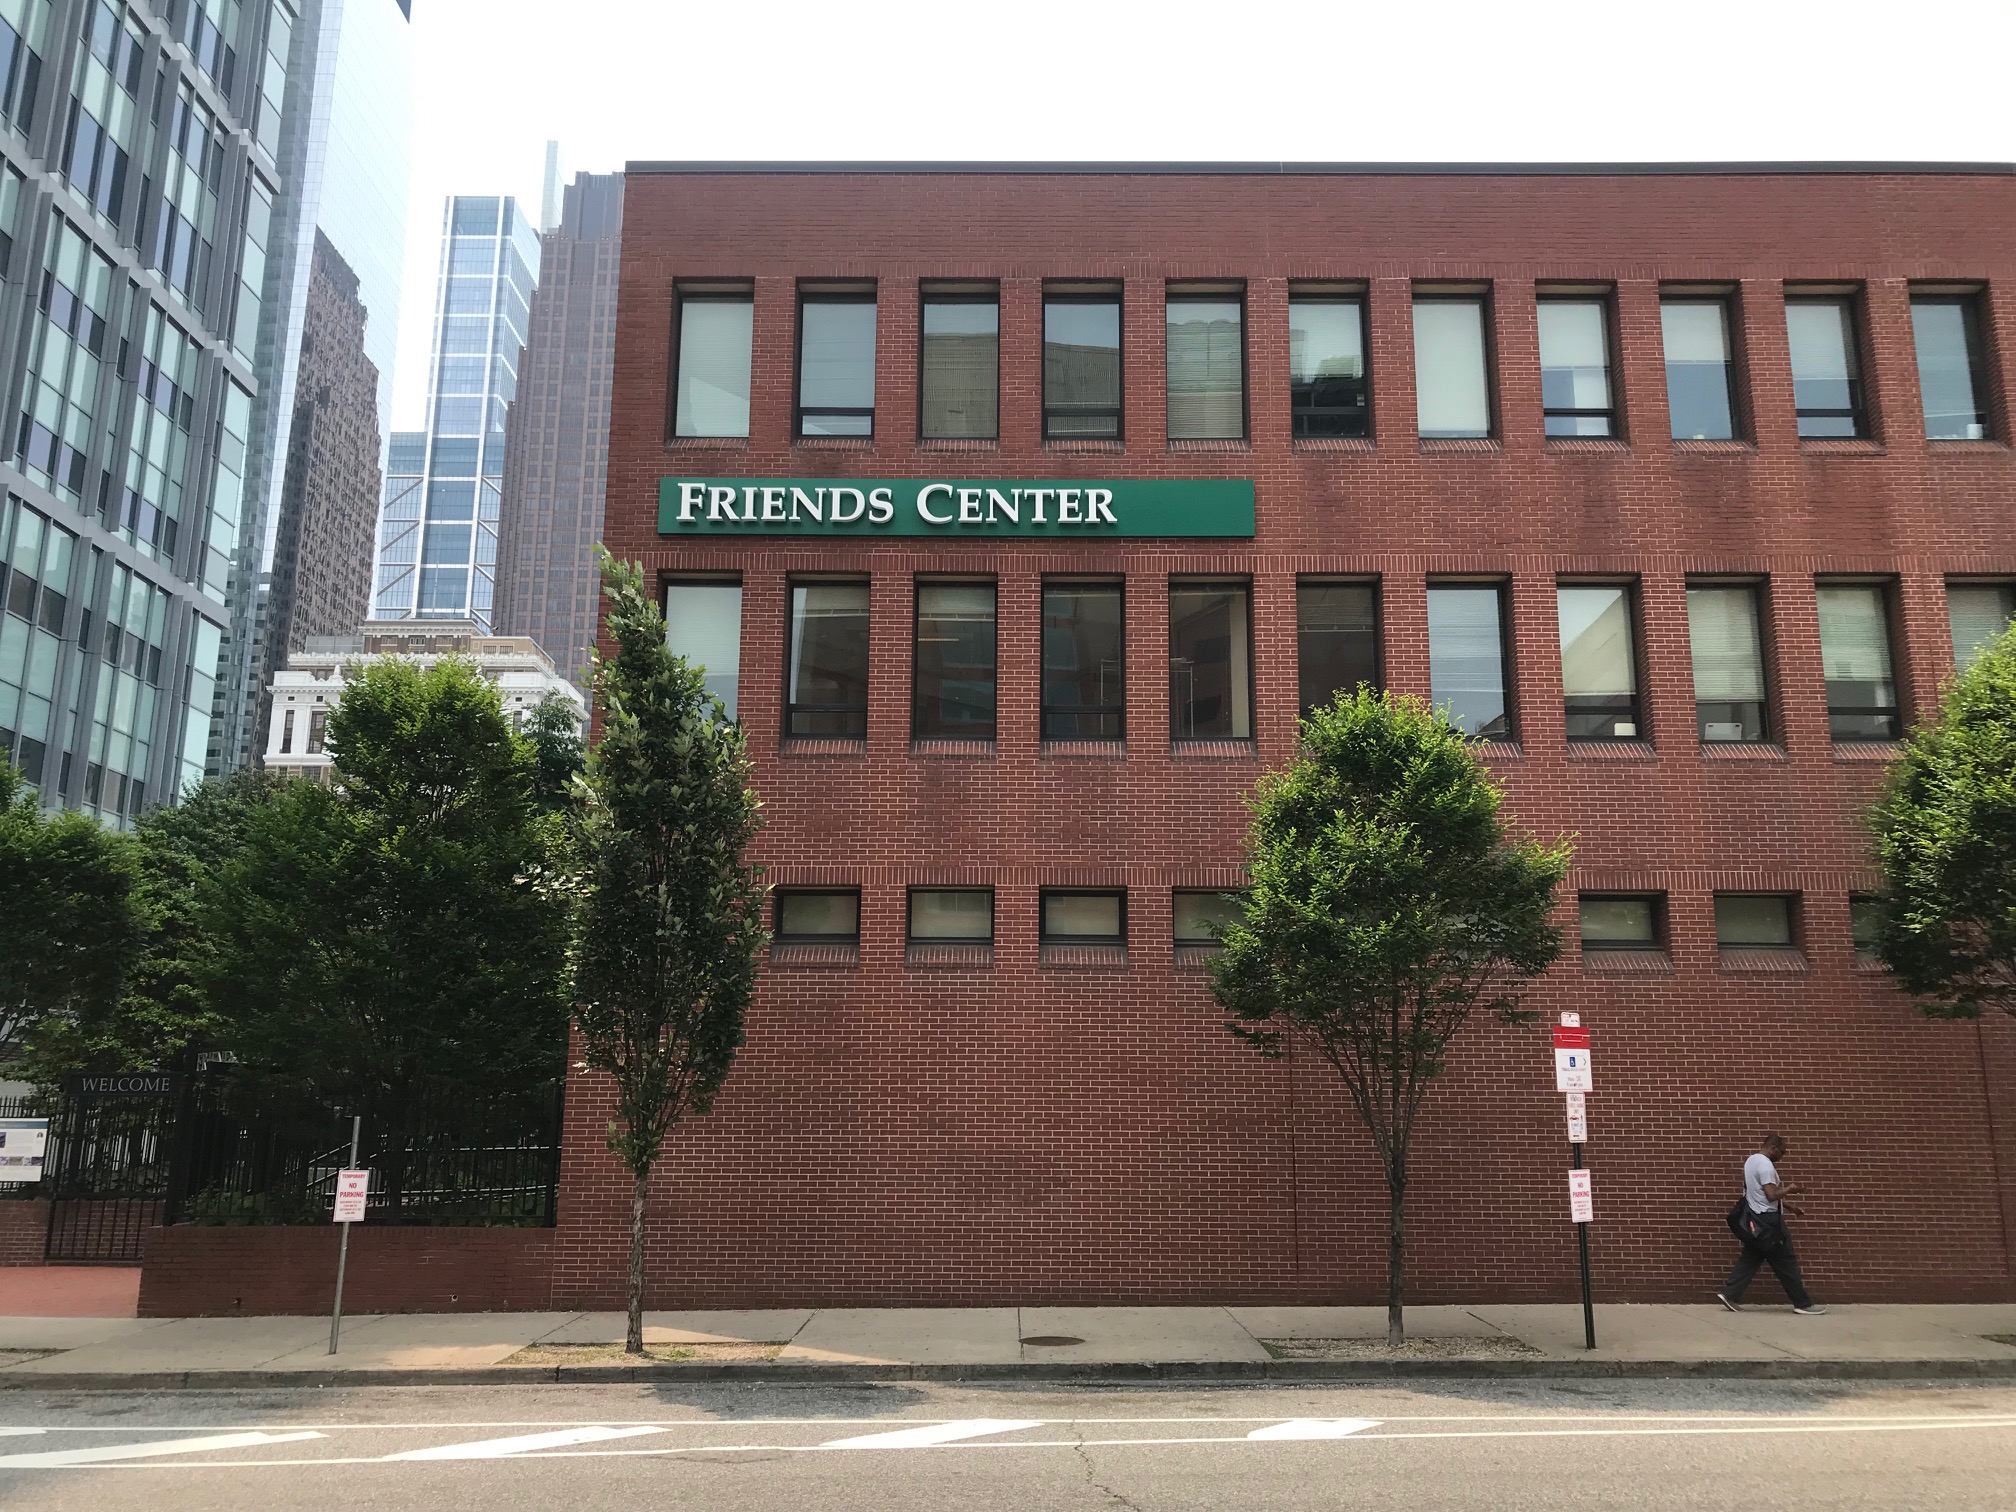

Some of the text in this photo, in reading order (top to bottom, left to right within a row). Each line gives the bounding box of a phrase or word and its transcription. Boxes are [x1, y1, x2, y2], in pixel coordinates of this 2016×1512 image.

[676, 482, 1118, 525] FRIENDS CENTER
[82, 1077, 171, 1092] WELCOME
